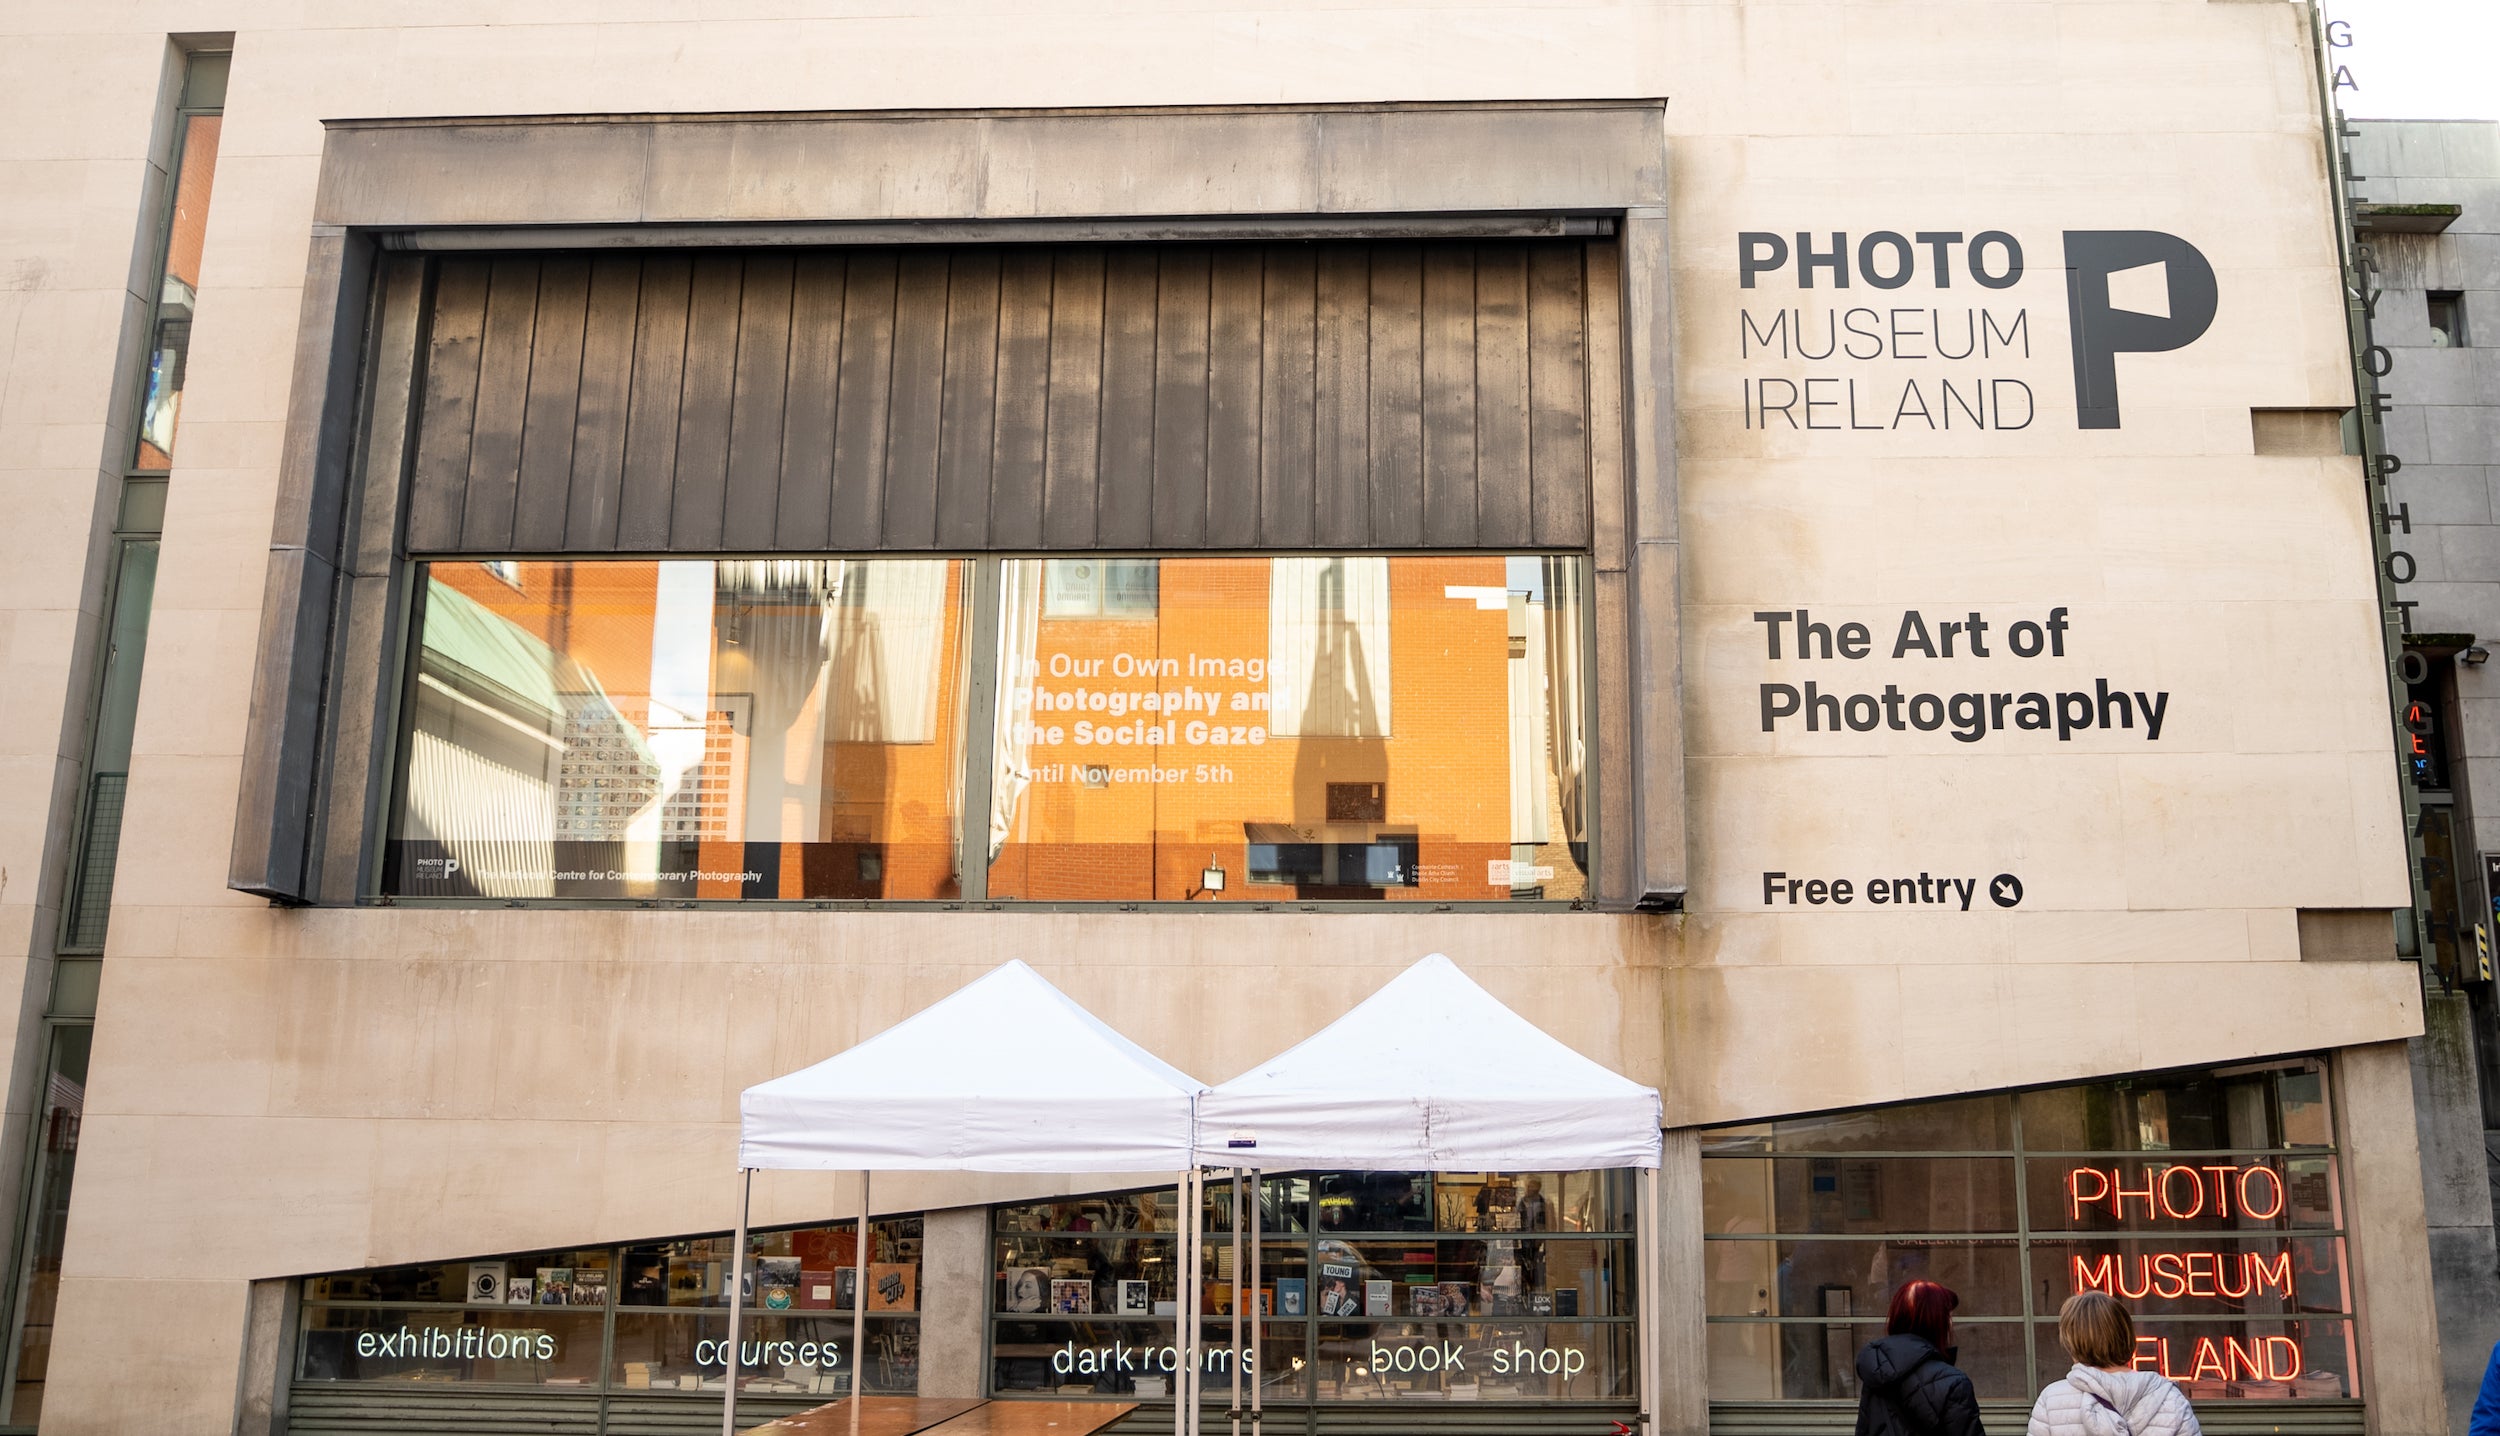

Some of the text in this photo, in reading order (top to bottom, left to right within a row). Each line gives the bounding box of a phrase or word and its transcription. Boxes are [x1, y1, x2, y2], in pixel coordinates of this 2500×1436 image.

[2325, 20, 2383, 320] GALLERY
[2361, 345, 2393, 425] OF
[1738, 230, 2024, 290] PHOTO
[1741, 308, 2030, 360] MUSEUM
[1744, 377, 2035, 430] IRELAND
[1753, 607, 2069, 660] The Art of
[1050, 653, 1105, 678] Our
[1112, 653, 1179, 678] Own
[1014, 686, 1292, 717] Photography and
[1760, 678, 2169, 743] Photography
[1013, 719, 1267, 746] the Social Gaze
[1027, 763, 1234, 784] ntil November 5th
[417, 858, 444, 866] PHOTO
[549, 869, 586, 881] Centre
[588, 869, 605, 881] for
[689, 869, 763, 884] Photography
[1762, 871, 1977, 912] Free entry
[2070, 1165, 2284, 1221] PHOTO
[1325, 1265, 1350, 1276] YOUNG
[2074, 1251, 2293, 1299] MUSEUM
[357, 1325, 555, 1360] exhibitions
[695, 1339, 838, 1367] courses
[1052, 1340, 1134, 1374] dark
[1371, 1340, 1585, 1381] book shop
[2131, 1336, 2301, 1382] ELAND
